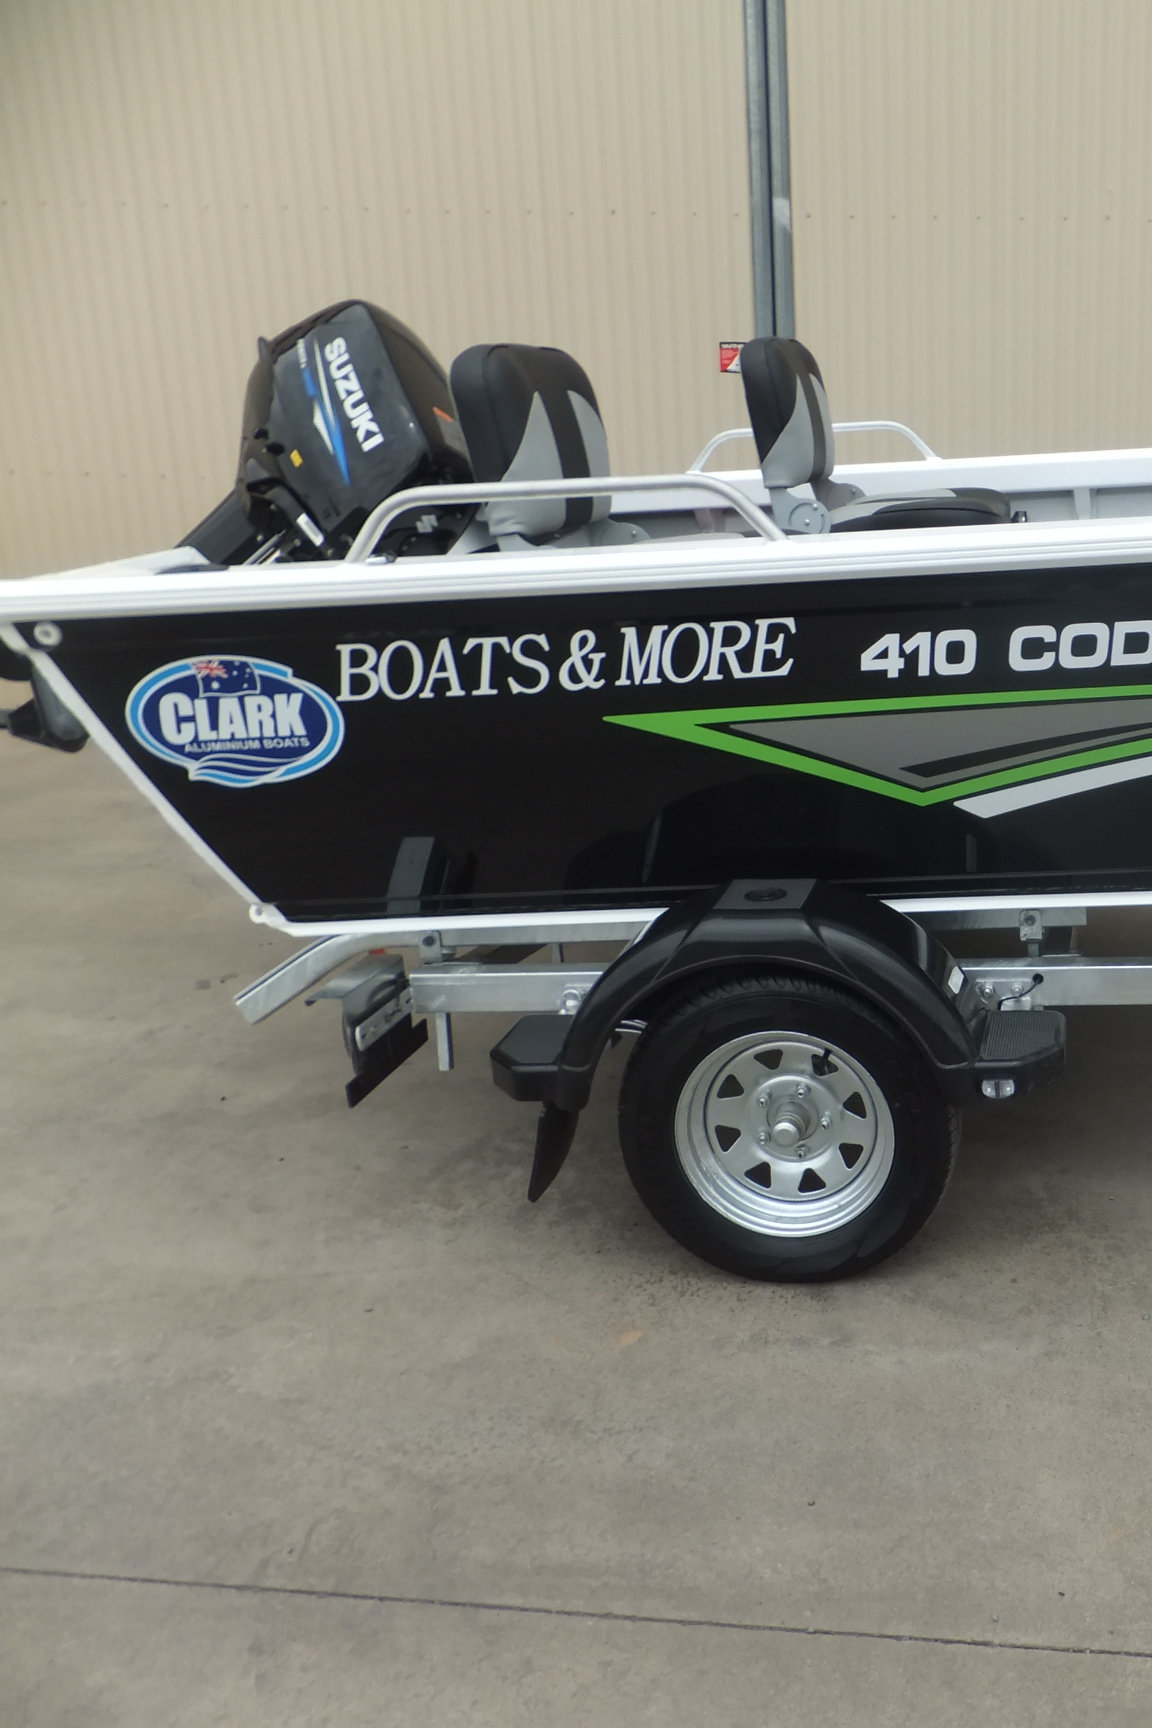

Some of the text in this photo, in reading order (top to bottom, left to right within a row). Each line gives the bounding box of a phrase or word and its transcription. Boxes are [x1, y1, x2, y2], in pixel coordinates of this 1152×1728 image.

[324, 337, 384, 452] SUZUKI
[614, 618, 797, 686] MORE
[860, 630, 977, 678] 410
[159, 692, 307, 745] CLARK
[184, 737, 311, 754] ALUMINIUM BOATS
